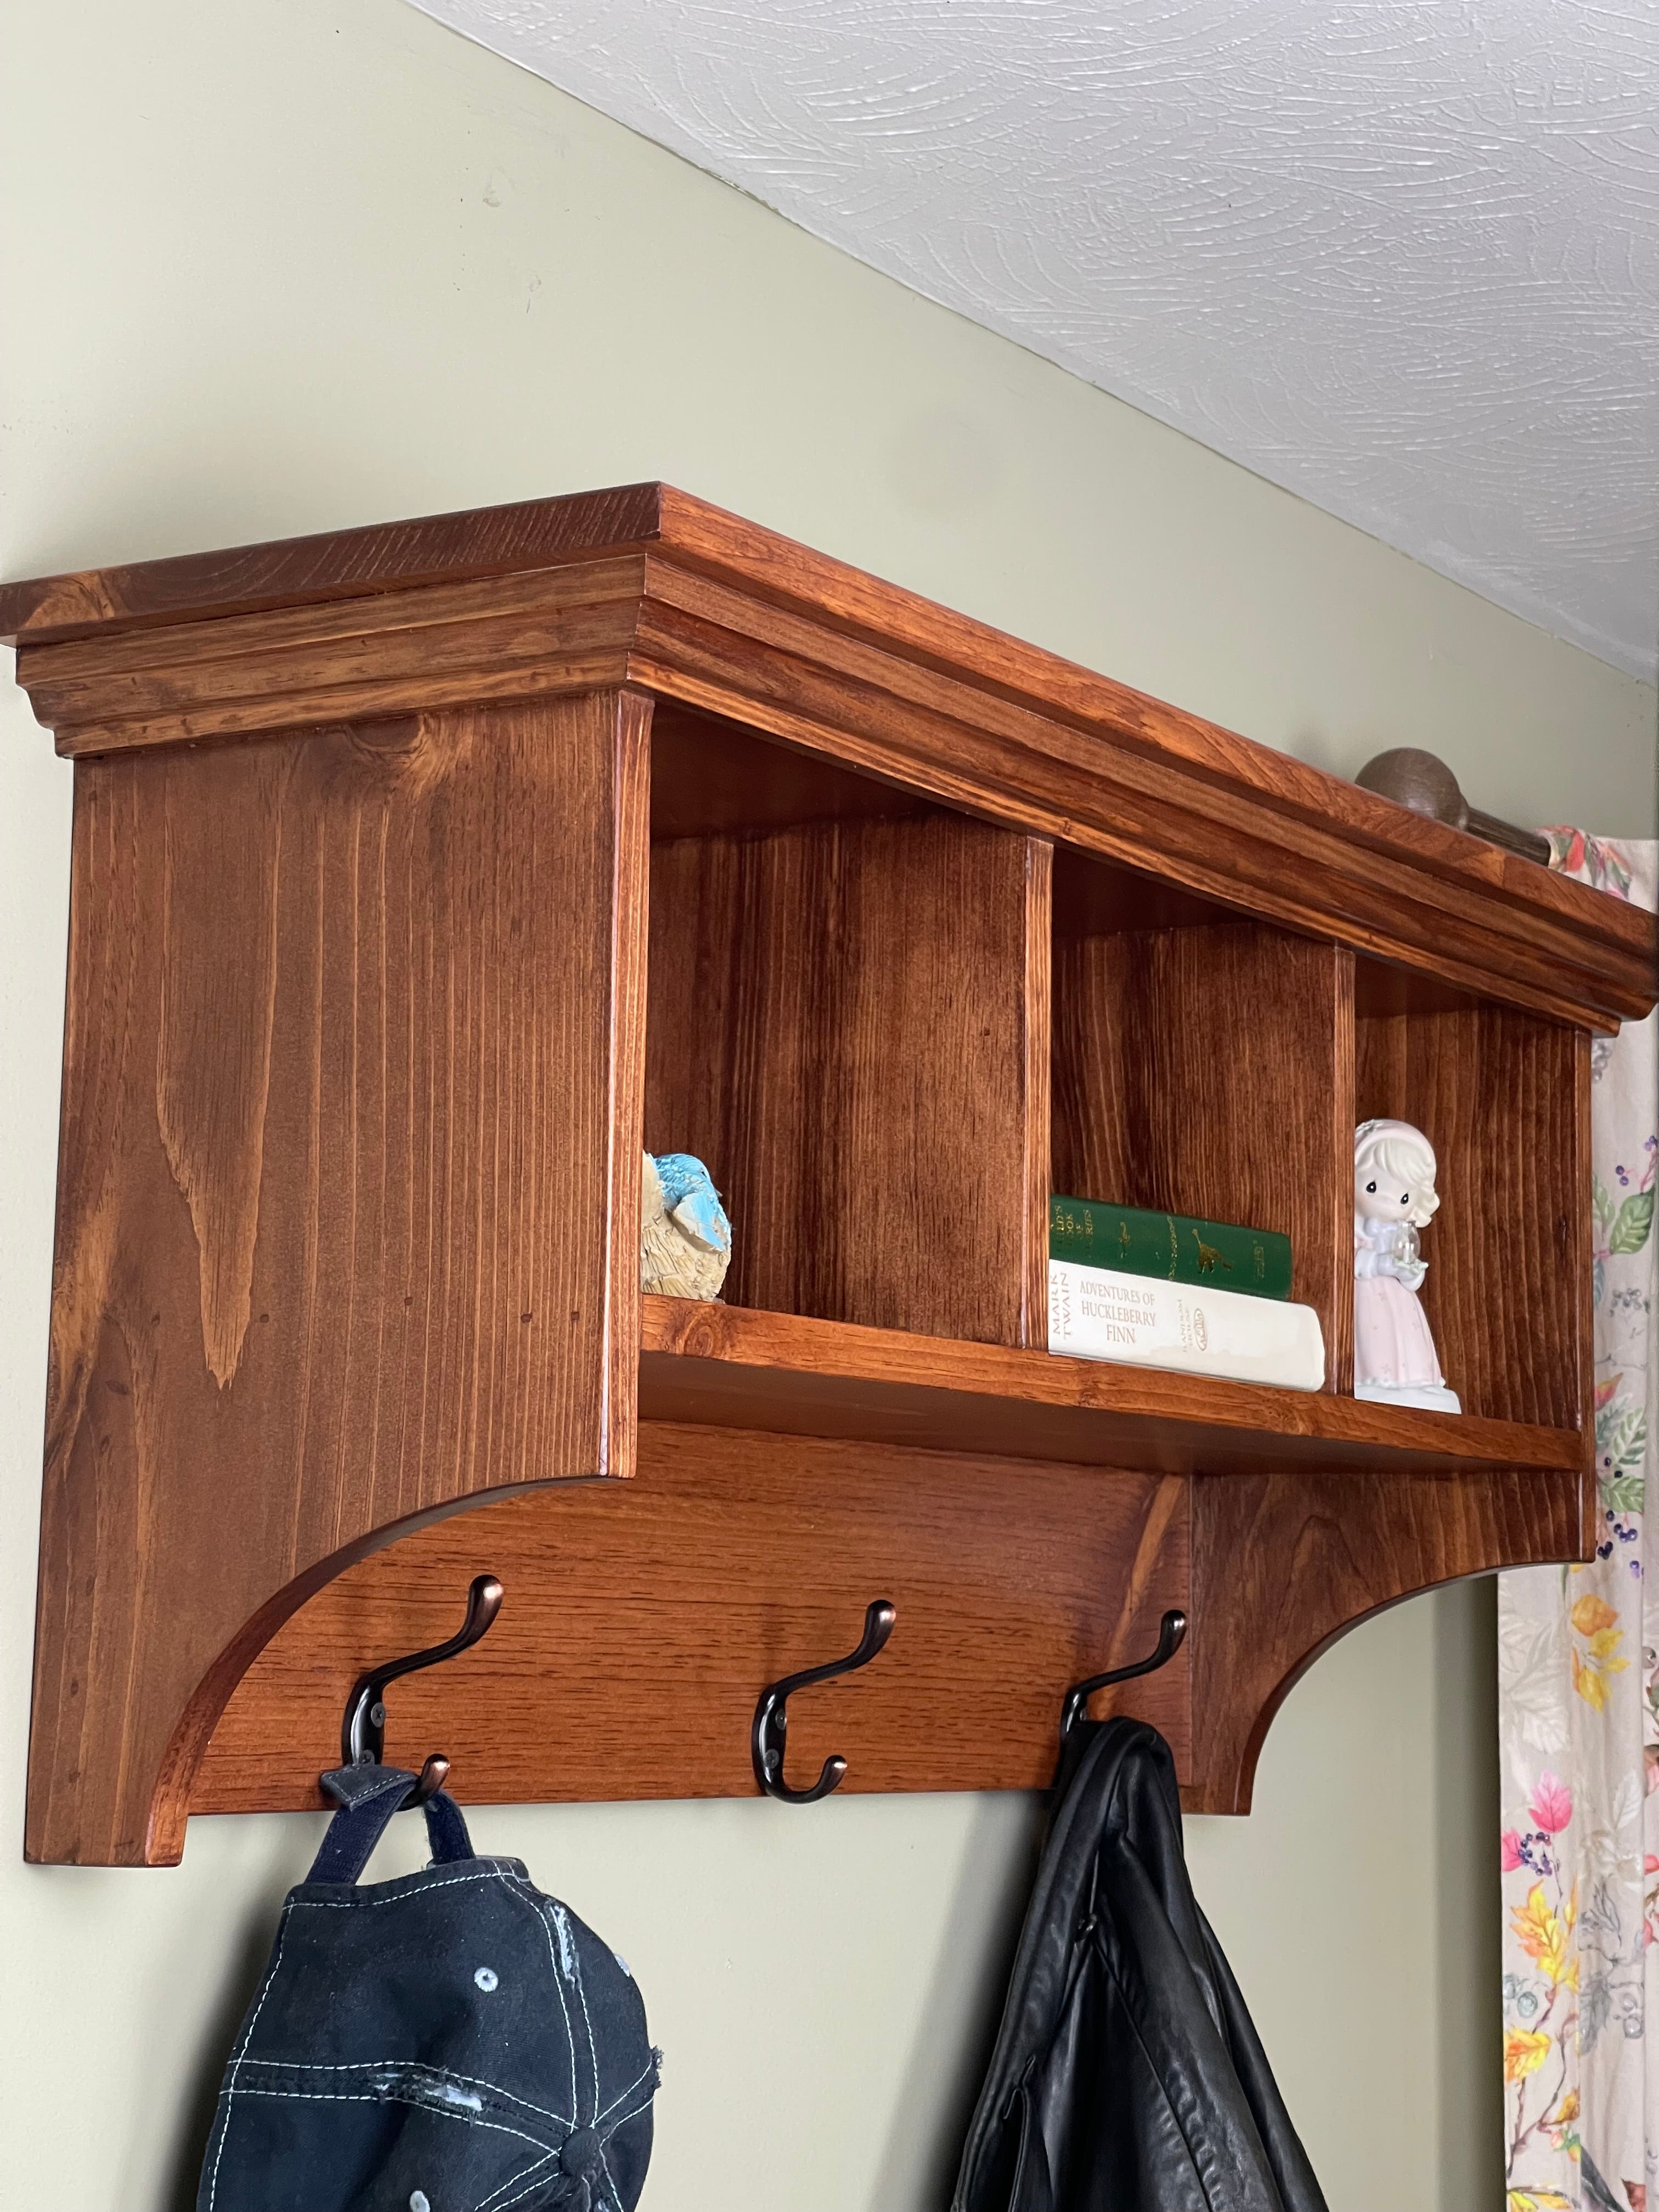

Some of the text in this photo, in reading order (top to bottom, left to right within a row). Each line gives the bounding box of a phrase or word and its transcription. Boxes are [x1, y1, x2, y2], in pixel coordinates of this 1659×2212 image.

[1050, 1273, 1060, 1335] MARK
[1060, 1272, 1071, 1340] TWAIN
[1080, 1280, 1155, 1306] ADVENTURES OF
[1081, 1300, 1156, 1327] HUCKLEBERRY
[1107, 1324, 1136, 1344] FINN
